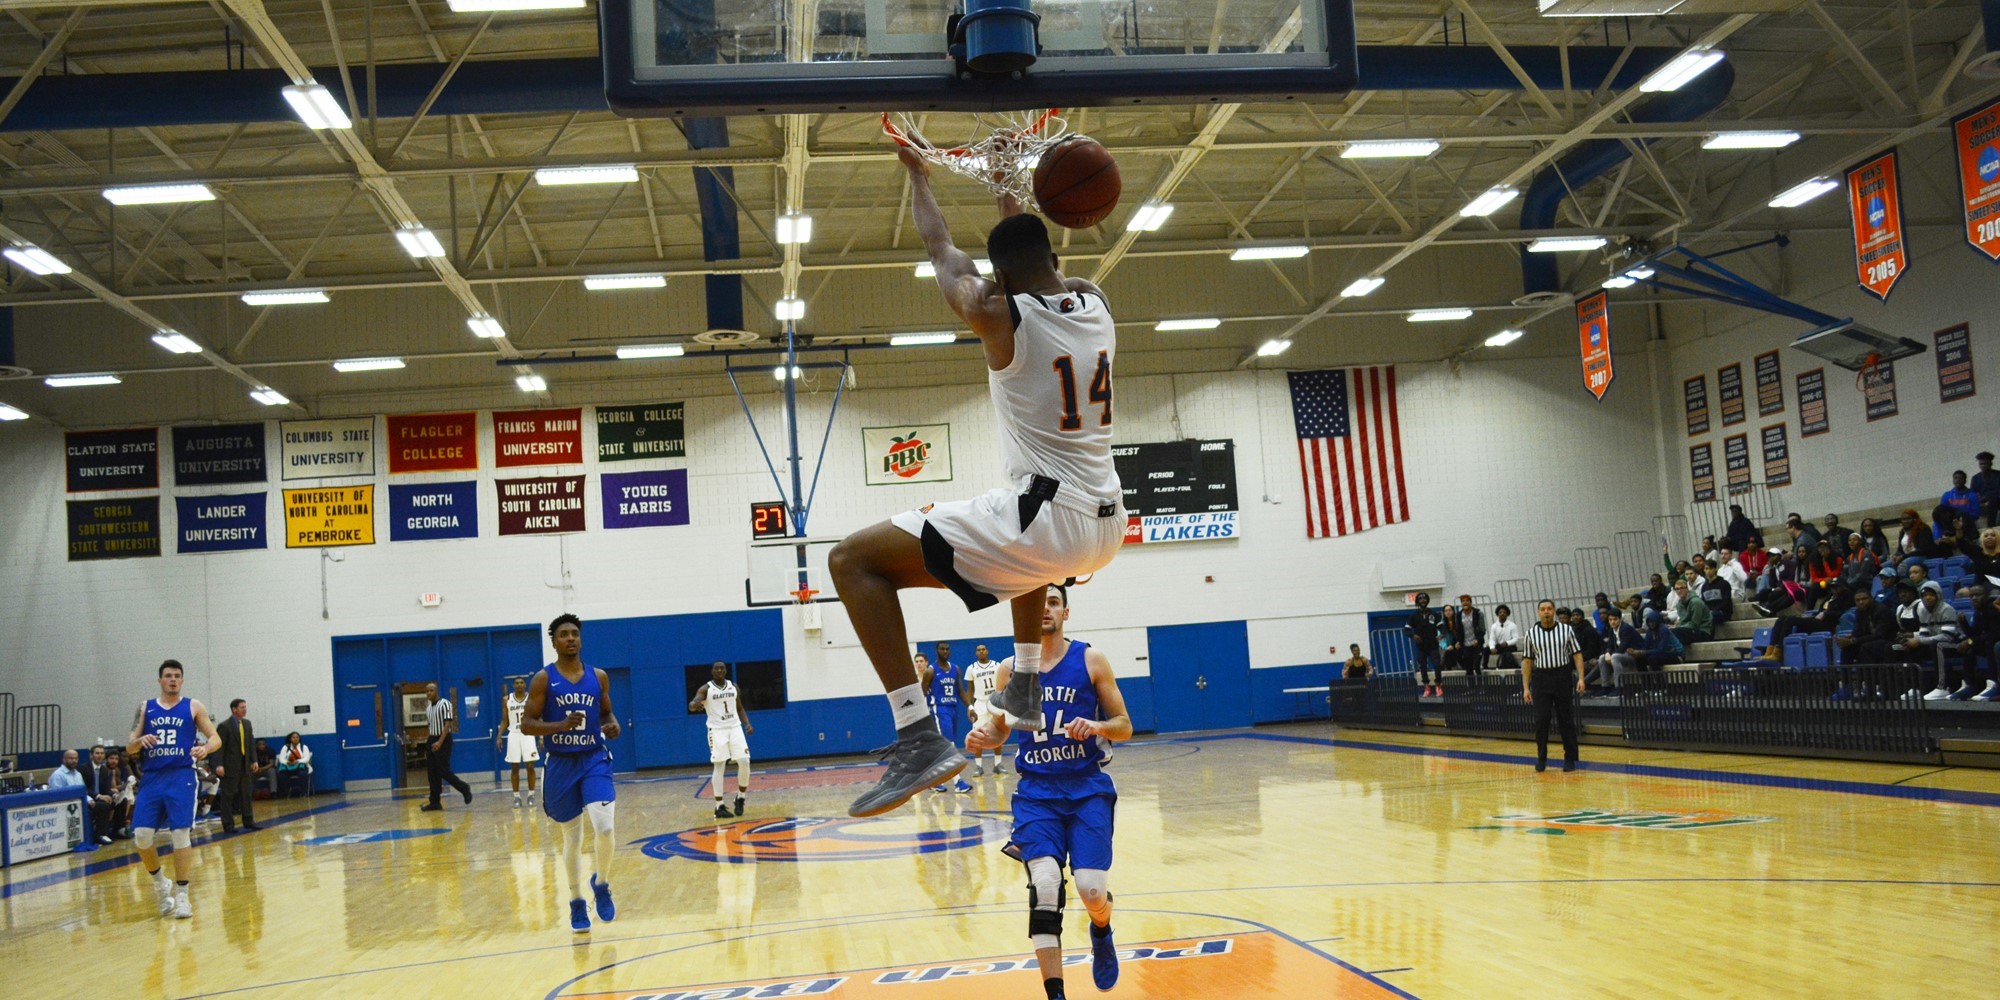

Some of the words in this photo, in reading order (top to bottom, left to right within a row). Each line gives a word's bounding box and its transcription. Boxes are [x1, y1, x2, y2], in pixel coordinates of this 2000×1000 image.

[1978, 217, 2000, 245] 200
[1052, 349, 1111, 431] 14
[598, 411, 635, 423] GEORGIA
[644, 408, 684, 421] COLLEGE
[401, 424, 463, 439] FLAGLER
[498, 420, 535, 433] FRANCIS
[544, 419, 577, 432] MARION
[635, 427, 646, 436] &
[185, 436, 254, 451] AUGUSTA
[285, 430, 333, 444] COLUMBUS
[342, 429, 370, 441] STATE
[68, 444, 116, 456] CLAYTON
[121, 442, 156, 453] STATE
[402, 446, 464, 460] COLLEGE
[502, 442, 573, 456] UNIVERSITY
[599, 443, 625, 456] STATE
[632, 439, 685, 453] UNIVERSITY
[1111, 447, 1139, 457] GUEST
[1200, 442, 1226, 451] HOME
[291, 451, 365, 466] UNIVERSITY
[884, 442, 931, 473] PBC
[79, 465, 145, 477] UNIVERSITY
[178, 458, 262, 474] UNIVERSITY
[1148, 471, 1174, 479] PERIOD
[504, 482, 558, 496] UNIVERSITY
[565, 481, 577, 492] OF
[621, 485, 667, 499] YOUNG
[1153, 485, 1192, 493] PLAYER-FOUL
[292, 491, 346, 504] UNIVERSITY
[353, 490, 364, 501] OF
[412, 494, 453, 507] NORTH
[93, 506, 132, 518] GEORGIA
[197, 505, 246, 519] LANDER
[289, 505, 317, 517] NORTH
[325, 503, 368, 516] CAROLINA
[502, 500, 531, 513] SOUTH
[538, 497, 582, 511] CAROLINA
[619, 501, 672, 515] HARRIS
[324, 519, 335, 528] AT
[407, 515, 459, 530] GEORGIA
[524, 516, 559, 529] AIKEN
[754, 507, 782, 532] 27
[1144, 515, 1183, 526] HOME
[1188, 514, 1205, 523] OF
[1211, 512, 1237, 522] THE
[78, 521, 150, 535] SOUTHWESTERN
[185, 527, 258, 542] UNIVERSITY
[1150, 523, 1233, 541] LAKERS
[299, 529, 362, 542] PEMBROKE
[71, 541, 99, 553] STATE
[104, 537, 158, 551] UNIVERSITY
[944, 685, 954, 696] 23
[983, 678, 994, 689] 11
[556, 693, 594, 707] NORTH
[1041, 686, 1077, 703] RTH
[723, 701, 729, 713] 1
[150, 716, 184, 727] NORTH
[157, 729, 177, 745] 32
[551, 734, 596, 745] GEORGIA
[149, 747, 184, 758] GEORGIA
[1024, 744, 1086, 764] GEORGIA
[12, 808, 37, 821] Official
[39, 806, 58, 816] Home
[16, 823, 23, 834] of
[24, 822, 35, 831] the
[36, 819, 57, 829] CCSU
[10, 837, 30, 847] Laker
[32, 833, 47, 844] Golf
[49, 831, 65, 839] Team
[872, 938, 1234, 985] Peach
